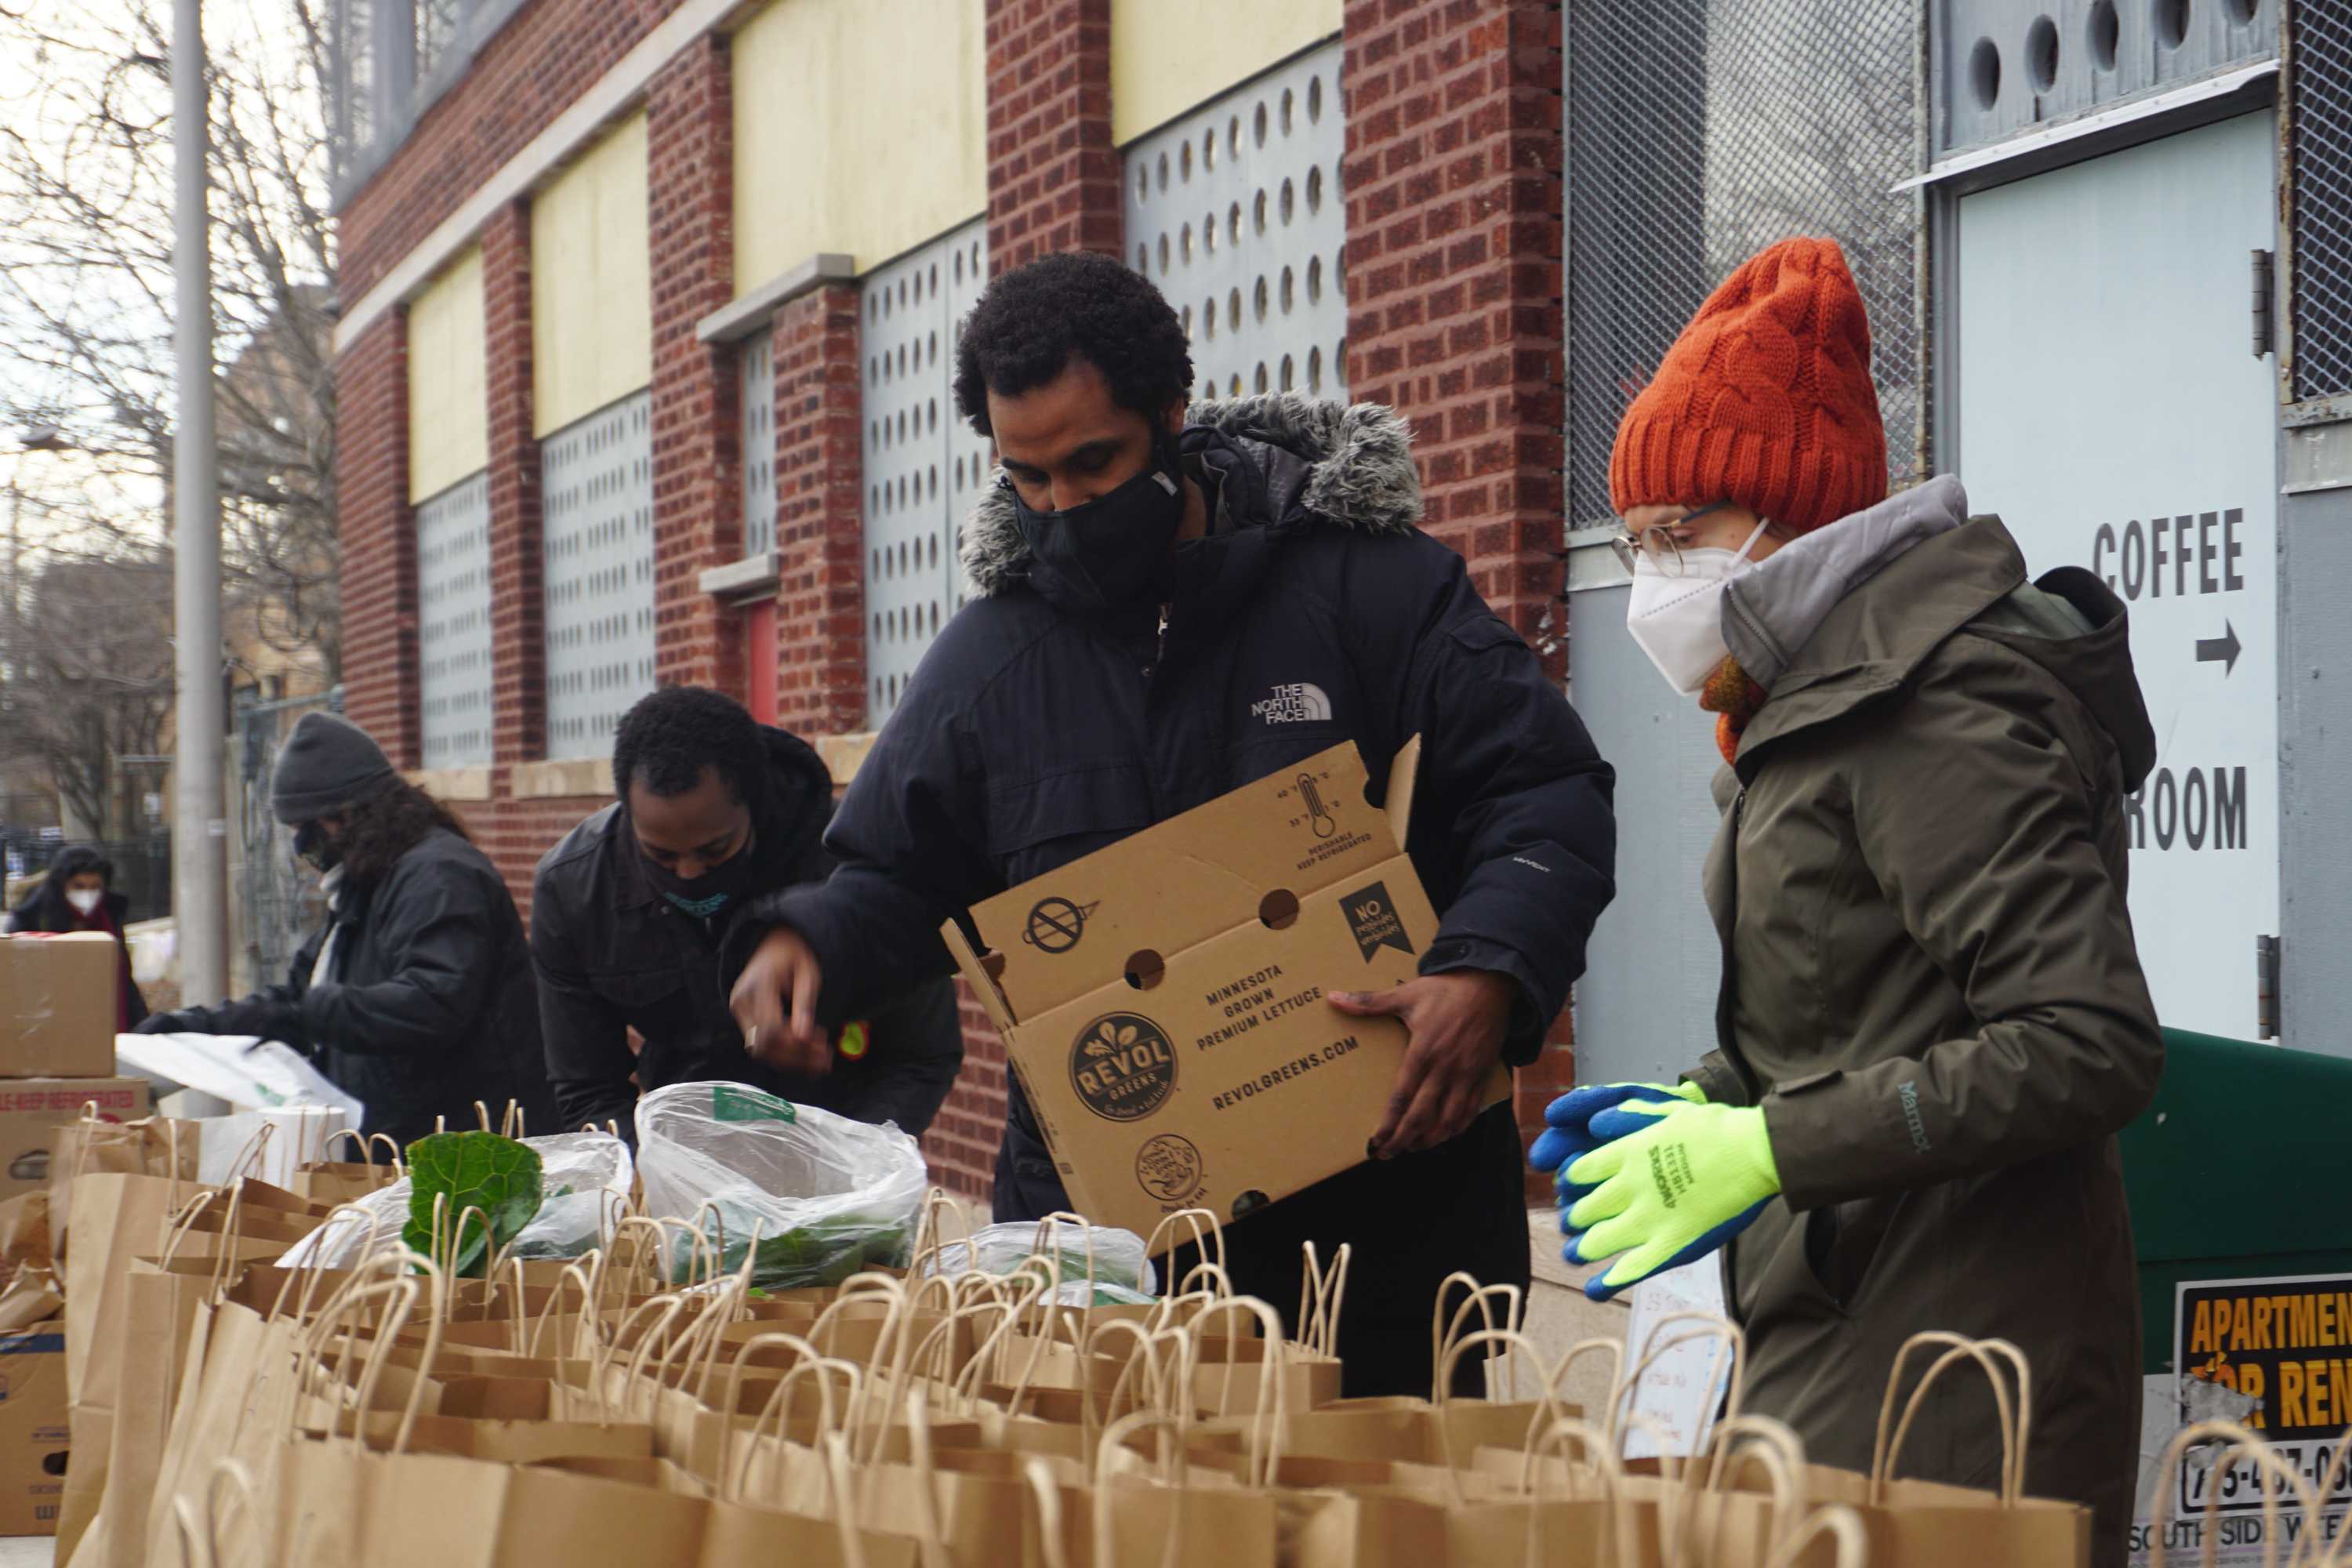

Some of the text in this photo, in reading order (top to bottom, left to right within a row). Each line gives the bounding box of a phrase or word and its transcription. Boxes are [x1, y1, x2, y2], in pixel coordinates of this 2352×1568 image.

[2093, 508, 2243, 601] COFFEE
[1250, 695, 1303, 717] NORTH
[1270, 684, 1302, 699] THE
[1265, 709, 1305, 724] FACE
[2124, 767, 2246, 851] ROOM
[1355, 899, 1381, 923] NO
[1205, 964, 1283, 1006] MINNESOTA
[1224, 987, 1274, 1018] GROWN
[1196, 986, 1323, 1051] PREMIUM LETTUCE
[1078, 1040, 1171, 1095] REVOL
[1109, 1073, 1156, 1101] GREENS
[1213, 1035, 1359, 1111] REVOLGREENS.COM
[1897, 1080, 1931, 1155] Marmot
[2190, 1293, 2352, 1353] APARTMEN
[2221, 1516, 2274, 1546] SID
